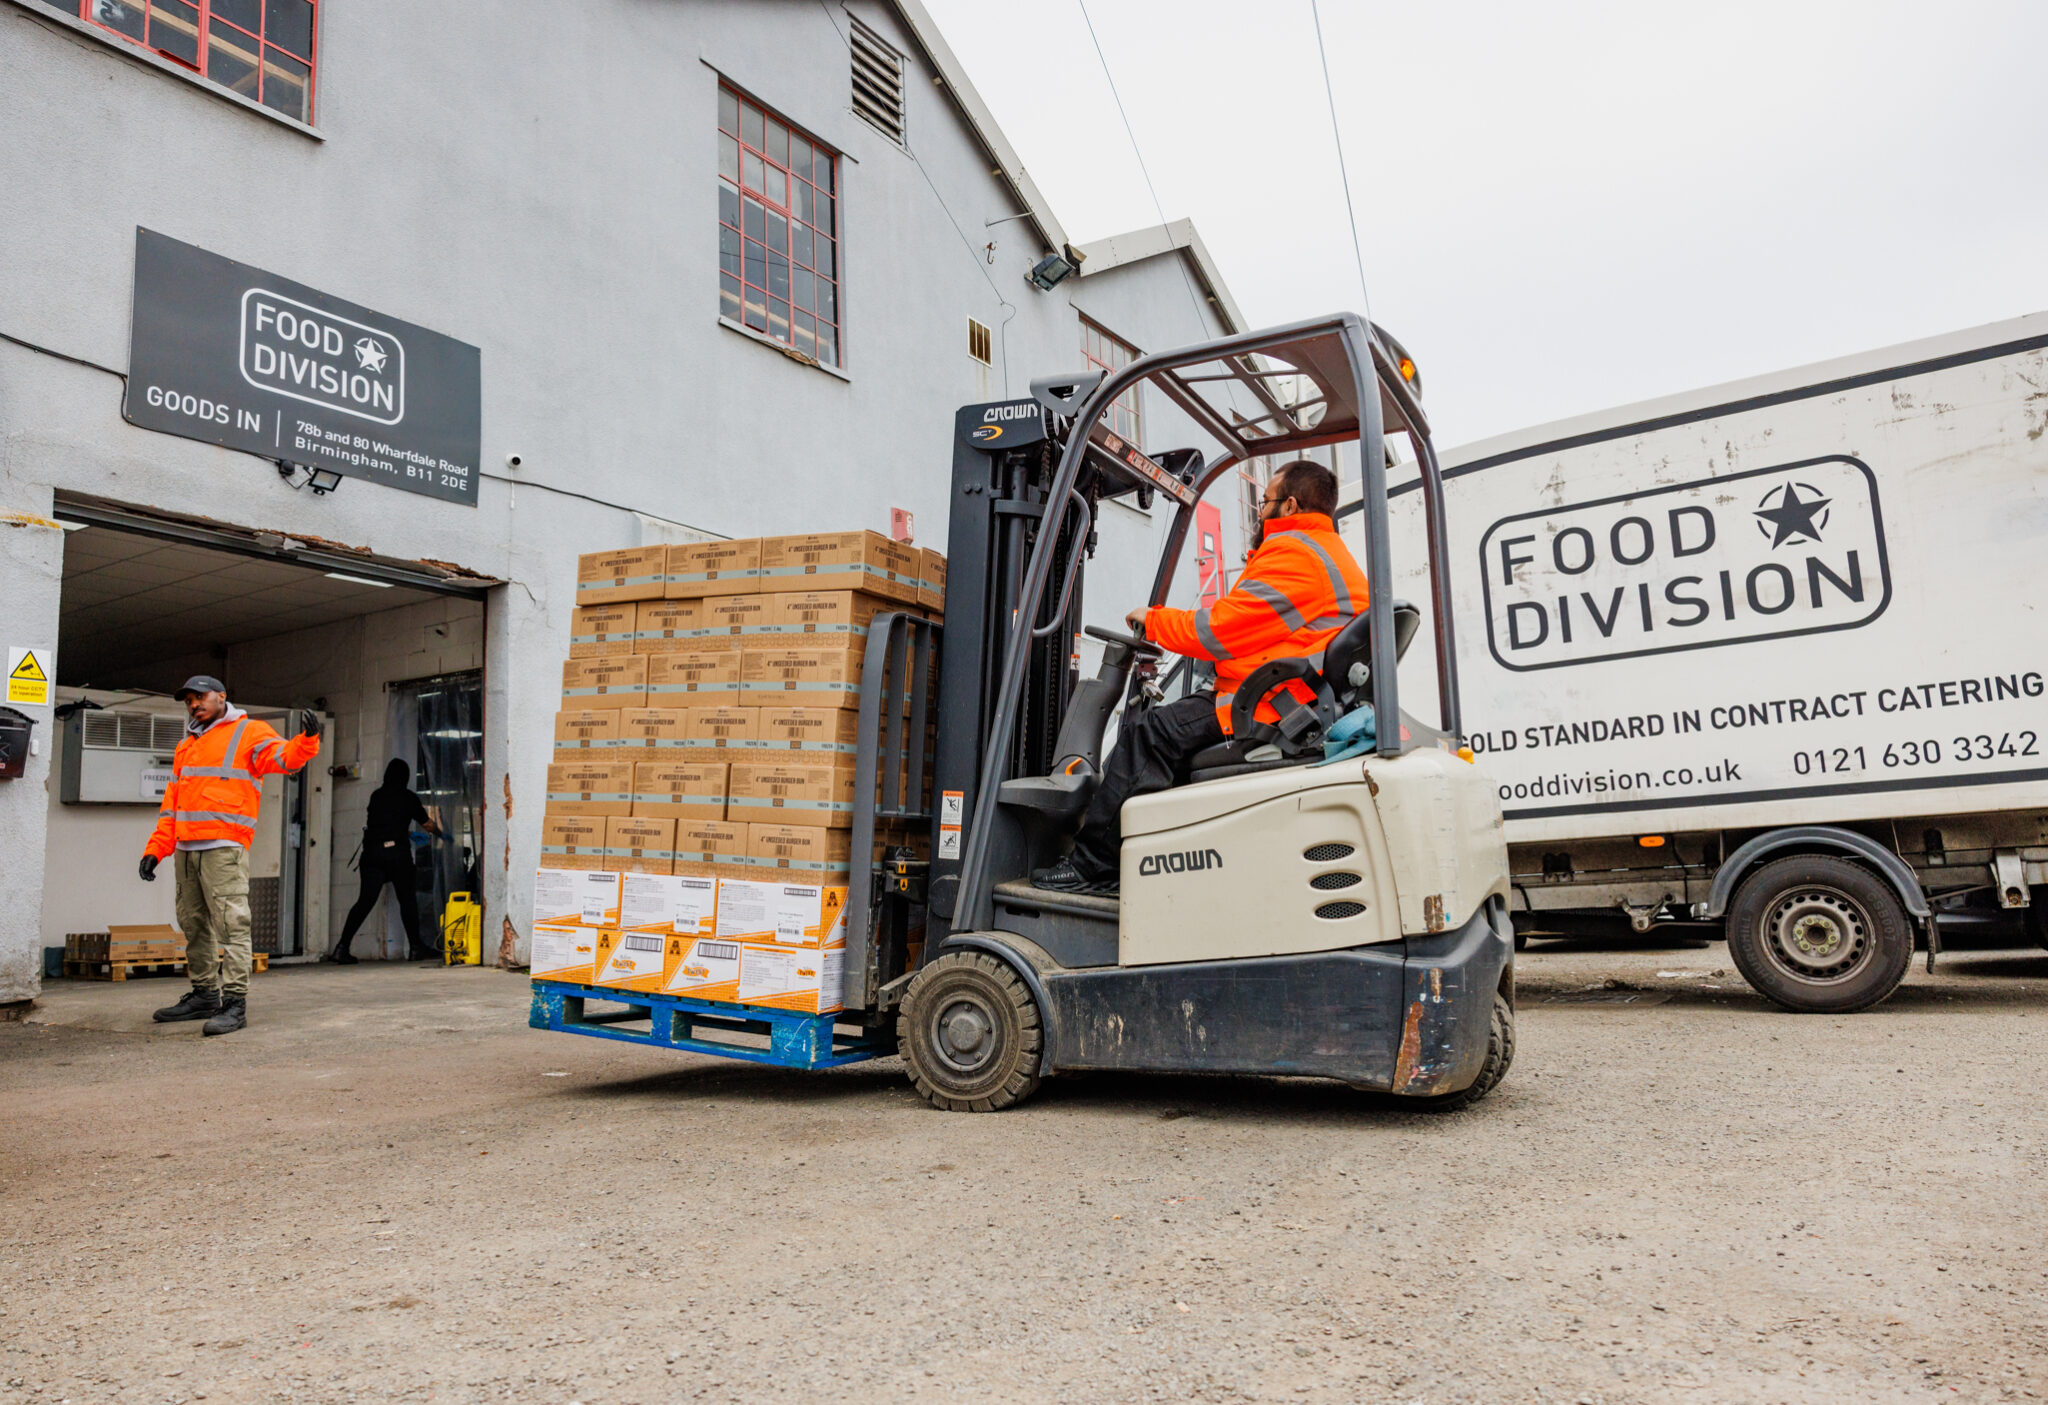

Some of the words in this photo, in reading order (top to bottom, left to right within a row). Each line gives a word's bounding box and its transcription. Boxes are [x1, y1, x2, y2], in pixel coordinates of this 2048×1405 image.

[255, 302, 344, 356] FOOD
[254, 342, 394, 412] DIVISION
[146, 385, 230, 425] GOODS
[237, 409, 261, 433] IN
[983, 402, 1039, 423] CROWN
[295, 436, 398, 474] Birmingham,
[406, 465, 432, 482] B11
[441, 474, 467, 491] 2DE
[296, 420, 321, 438] 78b
[325, 431, 350, 449] and
[353, 435, 370, 451] 80
[372, 440, 436, 468] Wharfdale
[439, 459, 469, 477] Road
[1500, 505, 1717, 586] FOOD
[1506, 549, 1866, 651] DIVISION
[1524, 714, 1665, 749] STANDARD
[1673, 709, 1702, 734] IN
[1710, 691, 1867, 730] CONTRACT
[1877, 672, 2044, 713] CATERING
[1498, 758, 1742, 801] ooddivision.co.uk
[1793, 746, 1866, 775] 0121
[1882, 739, 1941, 768] 630
[1953, 730, 2040, 762] 3342
[1139, 848, 1223, 877] CROWN
[1739, 916, 1776, 986] CHURCHILL
